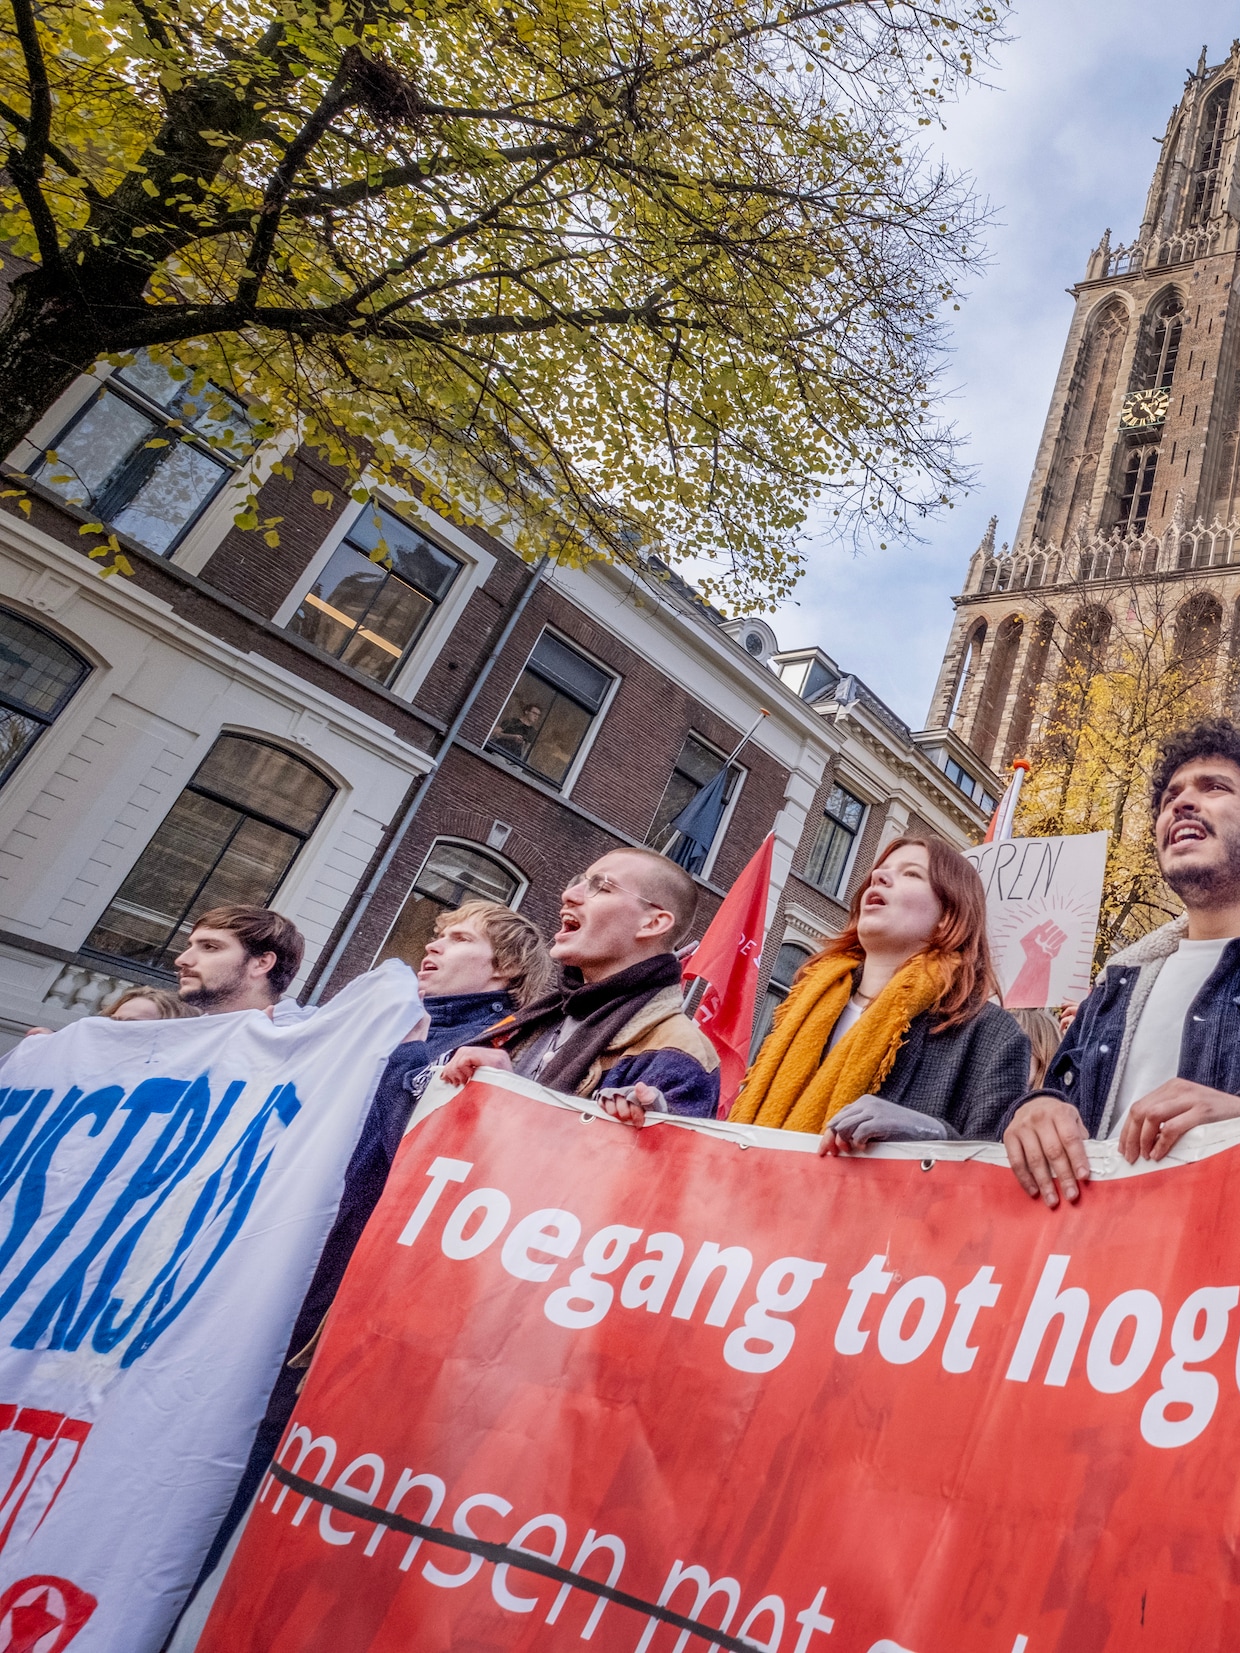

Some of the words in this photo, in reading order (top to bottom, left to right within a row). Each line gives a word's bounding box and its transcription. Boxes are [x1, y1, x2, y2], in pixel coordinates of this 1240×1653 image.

[398, 1156, 827, 1374] Toegang
[833, 1254, 1003, 1374] tot
[259, 1421, 626, 1642] mensen
